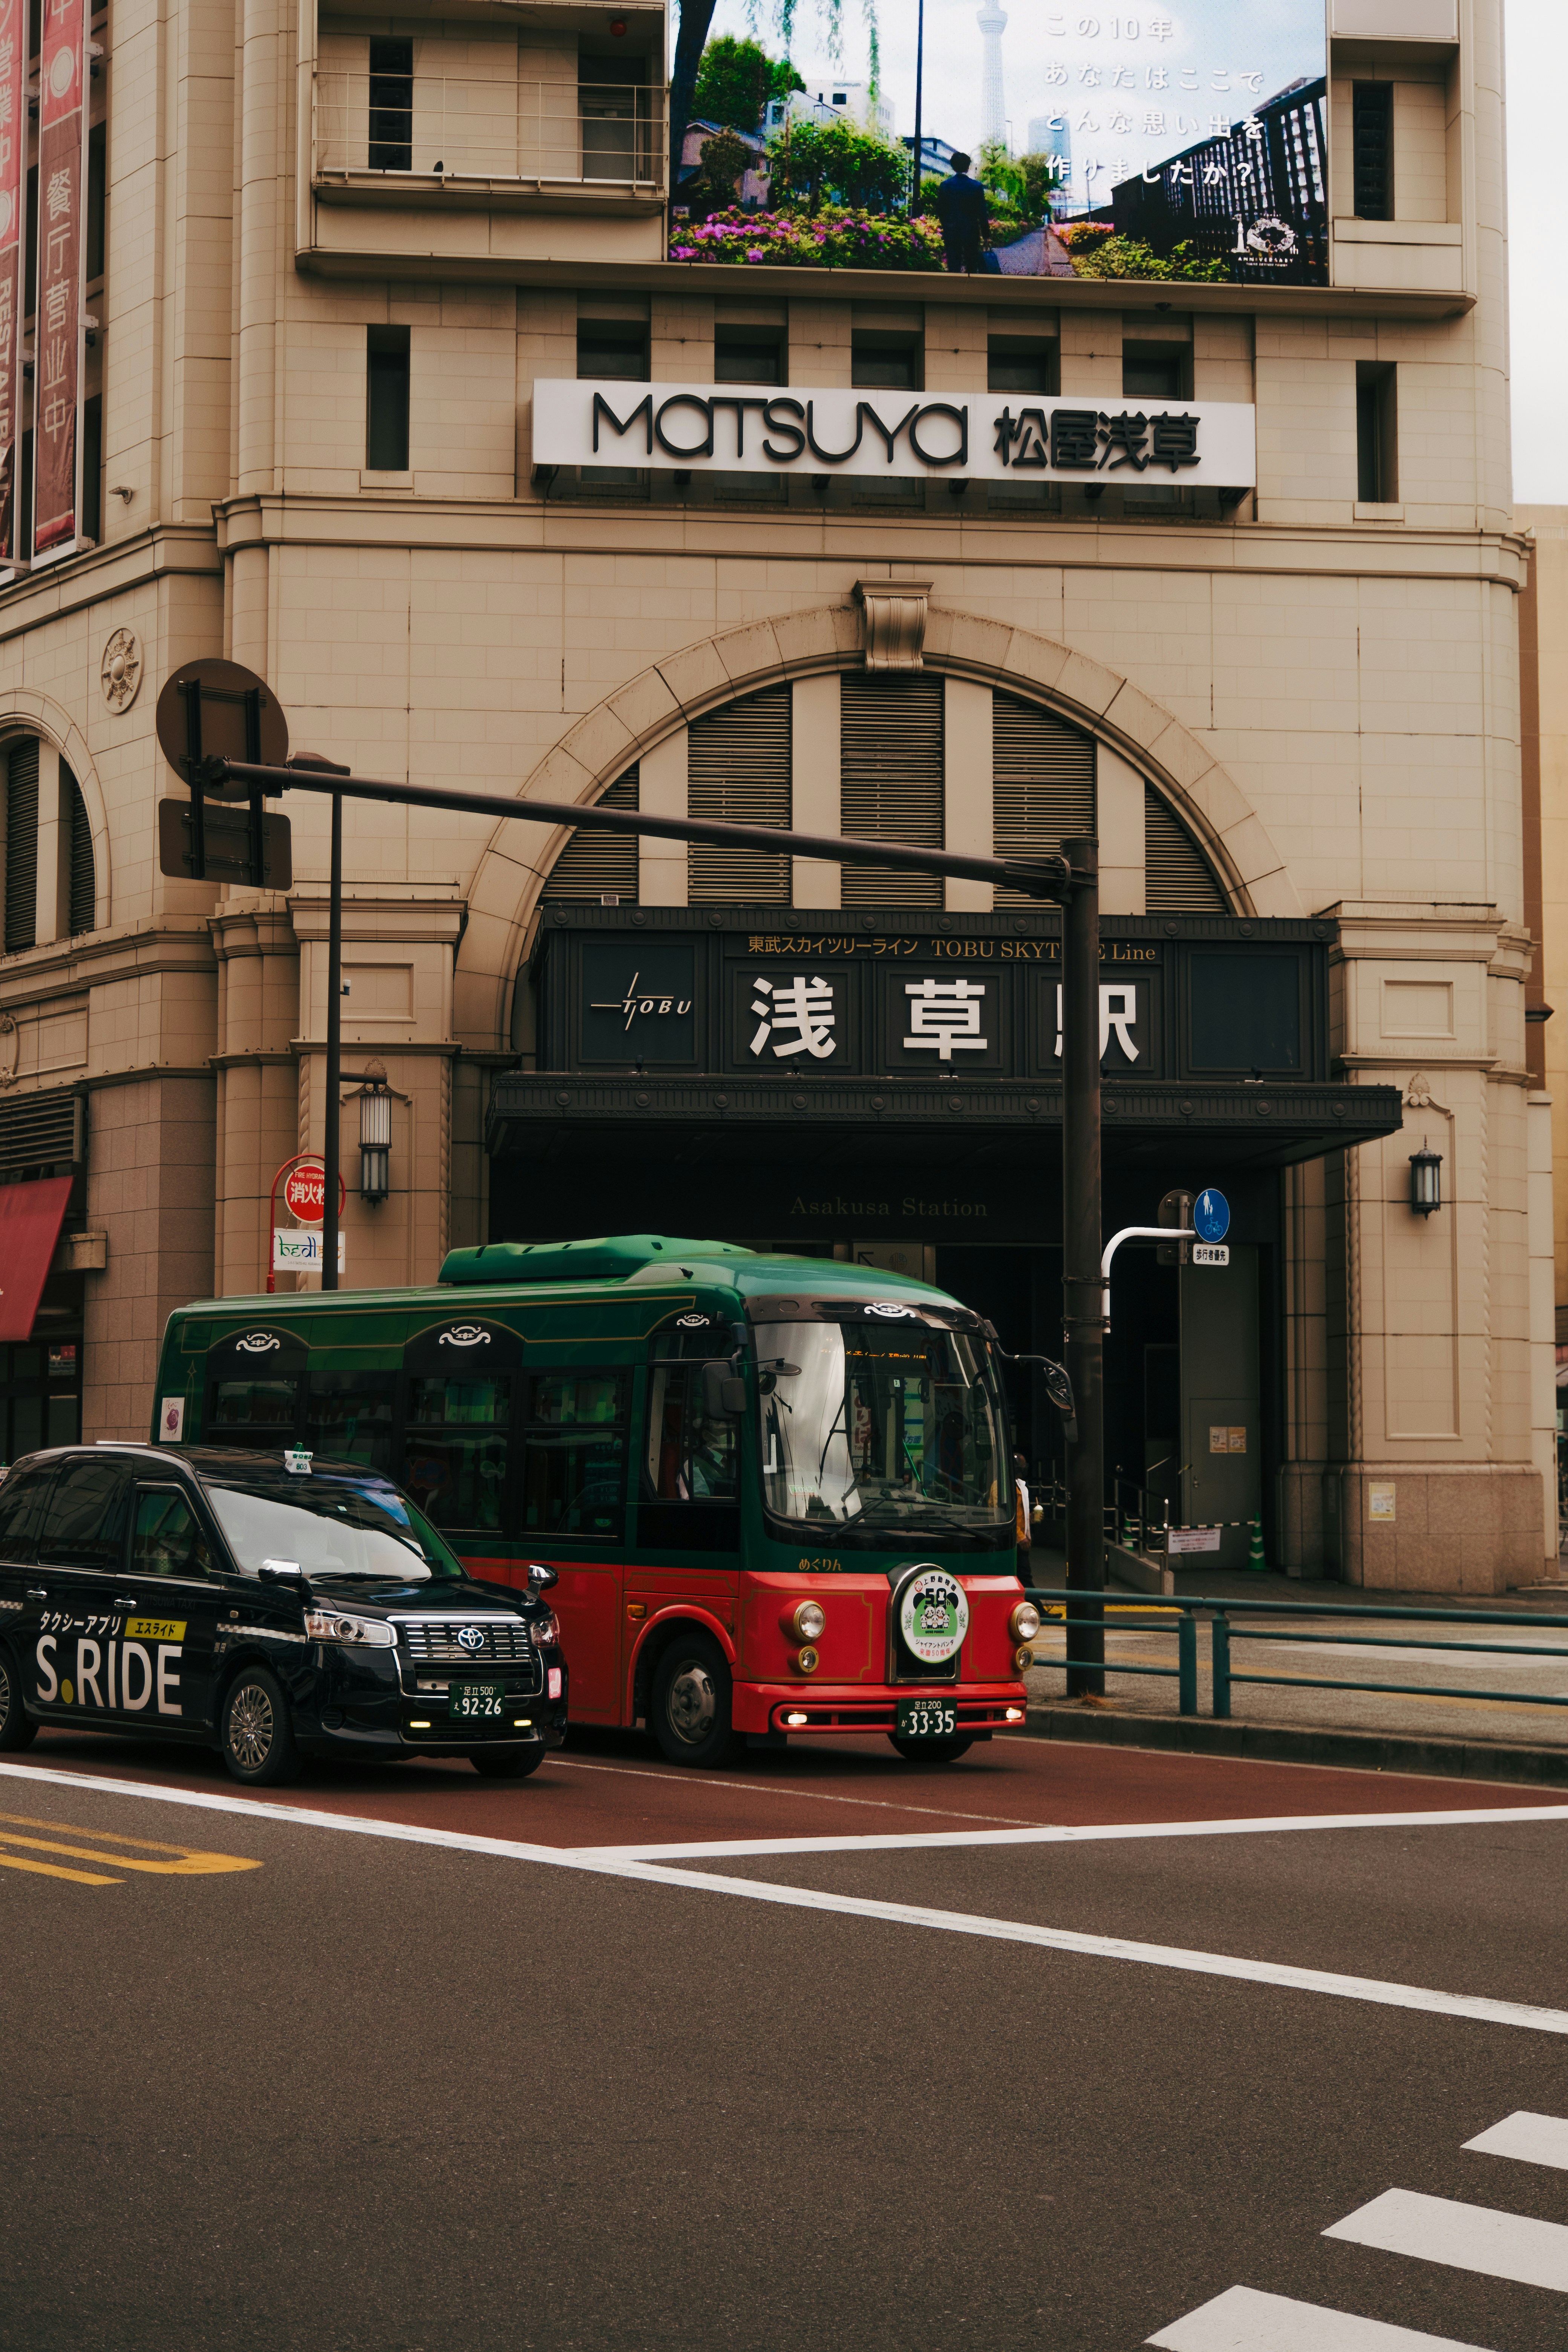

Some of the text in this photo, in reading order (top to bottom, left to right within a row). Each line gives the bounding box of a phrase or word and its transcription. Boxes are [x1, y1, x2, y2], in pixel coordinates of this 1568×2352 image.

[1044, 62, 1265, 93] あなたはここで
[1045, 107, 1265, 139] どんな思い出を
[44, 167, 71, 443] 餐厅营业中
[993, 406, 1201, 473] 松屋浅草
[749, 936, 1155, 960] 東武スカイツリーライン TOBU SKYTE Line
[622, 1000, 691, 1014] TOBU
[790, 1196, 988, 1216] Asakusa Station
[1196, 1248, 1226, 1261] 歩行者優先
[799, 1558, 843, 1571] めぐりん
[178, 1597, 196, 1610] TAXI
[40, 1611, 121, 1635] タクシーアプリ
[135, 1622, 176, 1637] エスライド
[37, 1635, 182, 1716] S.RIDE
[462, 1698, 502, 1715] 92-26
